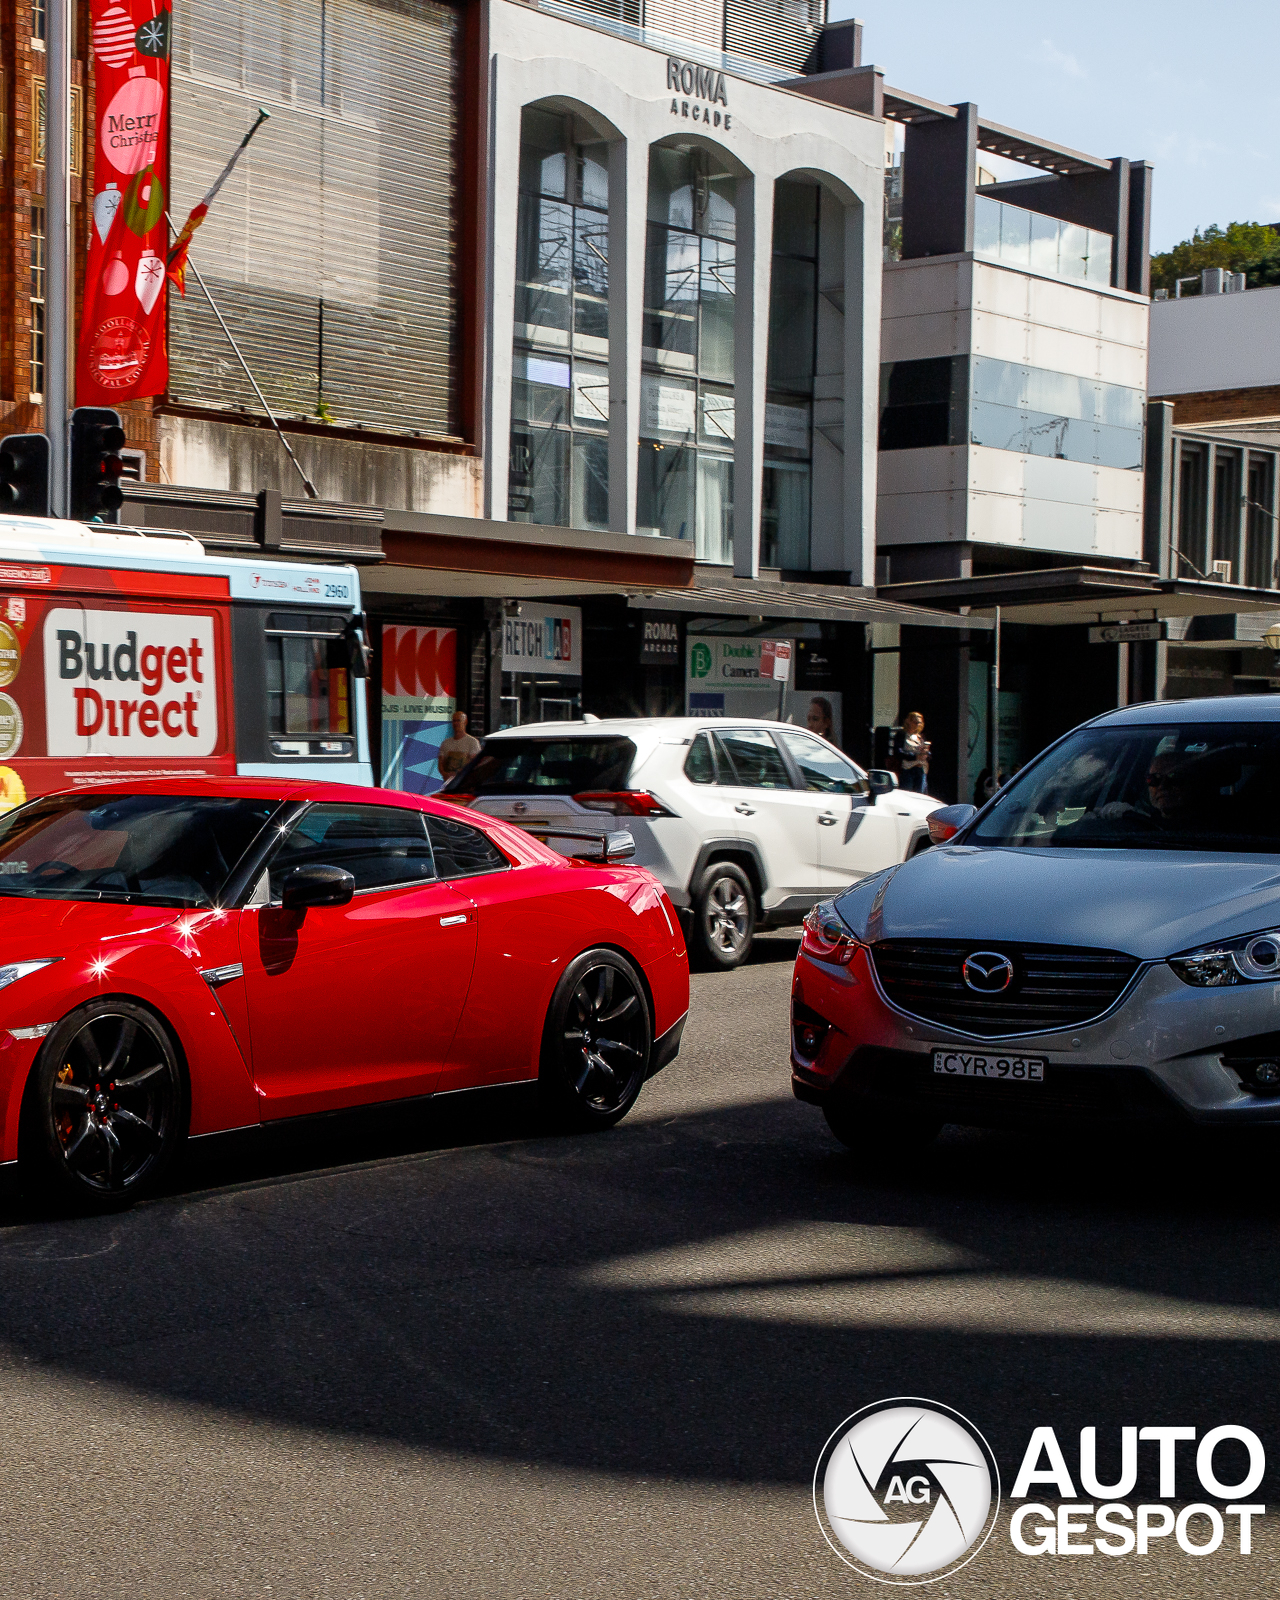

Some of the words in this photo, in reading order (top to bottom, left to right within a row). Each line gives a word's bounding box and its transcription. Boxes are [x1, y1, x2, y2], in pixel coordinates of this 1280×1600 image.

[666, 57, 728, 107] ROMA
[108, 113, 158, 133] Merr
[670, 98, 732, 131] ARCADE
[109, 131, 158, 149] Christa
[324, 584, 349, 599] 2960
[504, 619, 543, 657] RETCH
[644, 621, 678, 640] ROMA
[643, 643, 678, 653] ARCADE
[723, 643, 754, 659] Double
[56, 629, 204, 697] Budget
[722, 663, 759, 678] Camera
[73, 687, 200, 739] Direct
[404, 704, 423, 714] LIVE
[425, 704, 453, 714] MUSIC
